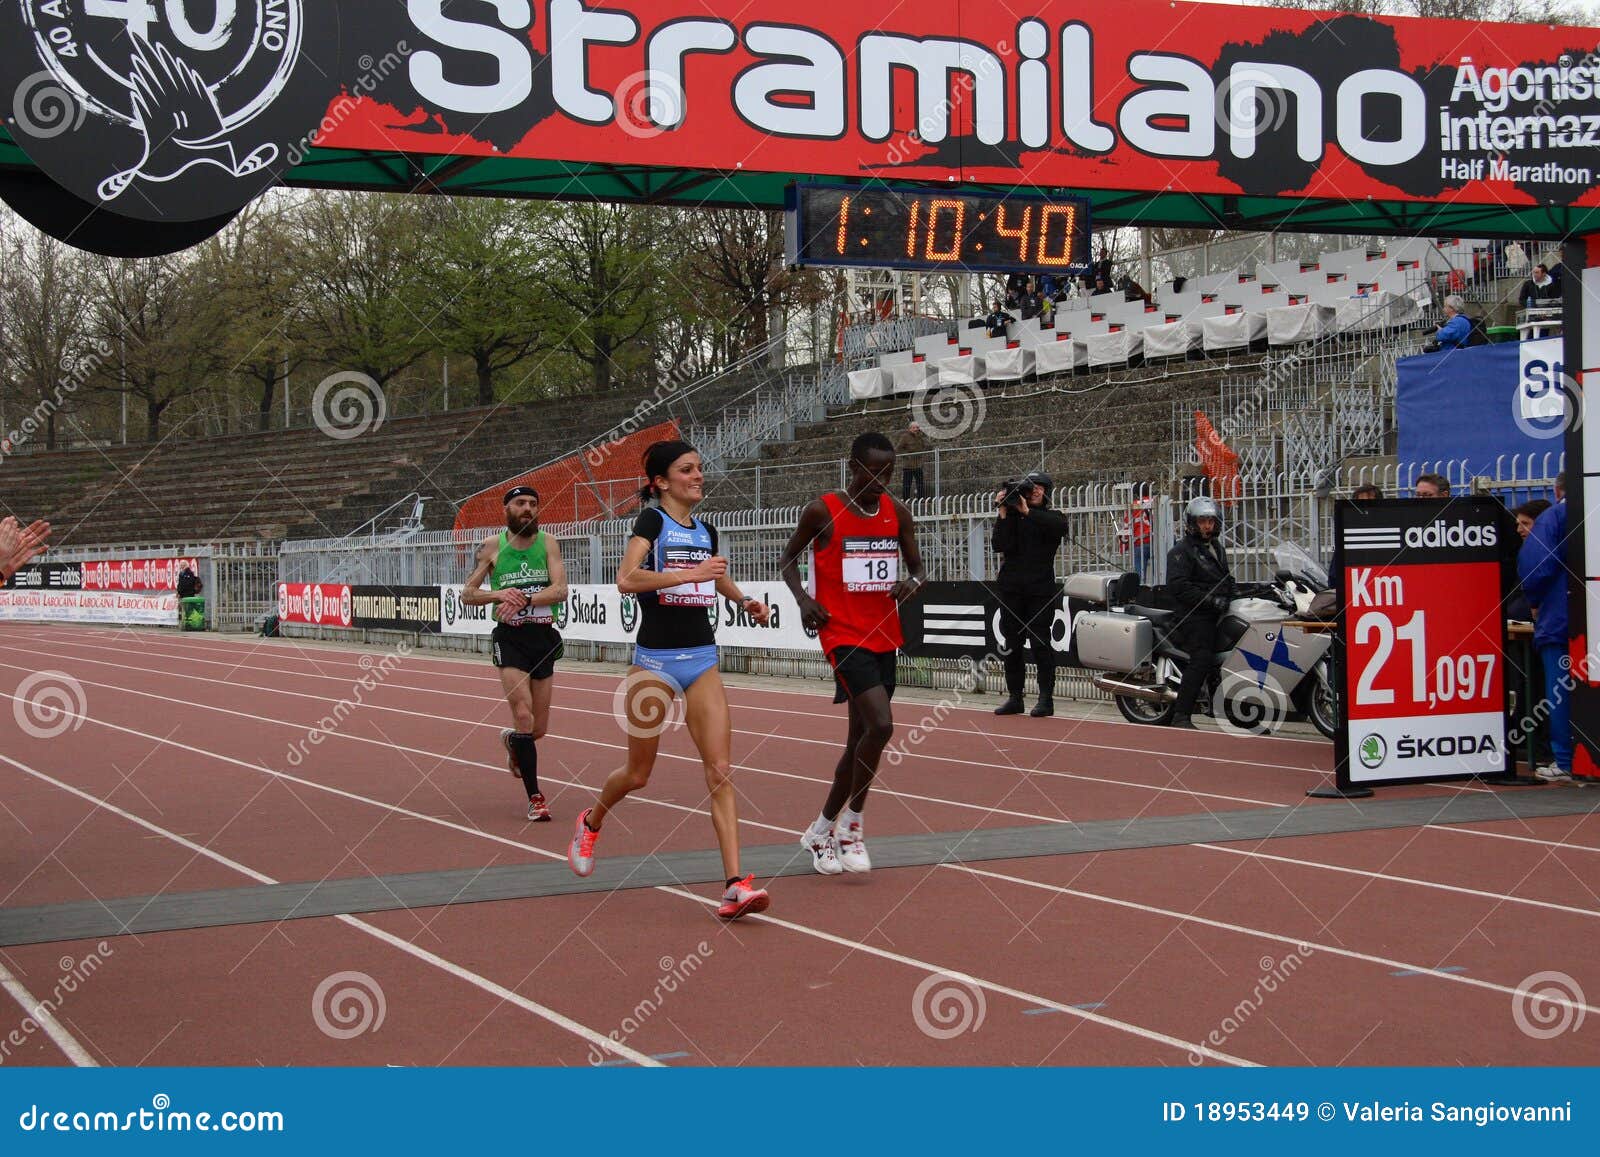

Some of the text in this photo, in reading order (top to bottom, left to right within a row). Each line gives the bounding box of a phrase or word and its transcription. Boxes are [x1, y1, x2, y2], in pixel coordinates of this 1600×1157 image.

[408, 0, 1426, 166] Stramilano
[1441, 158, 1590, 184] Half Marathon
[1404, 519, 1497, 549] adidas
[864, 560, 889, 580] 18
[664, 592, 717, 605] Stramilan
[847, 582, 895, 592] Stramila
[1351, 568, 1404, 607] Km
[324, 596, 340, 617] R101
[571, 588, 607, 625] Škoda
[1396, 734, 1497, 759] ŠKODA
